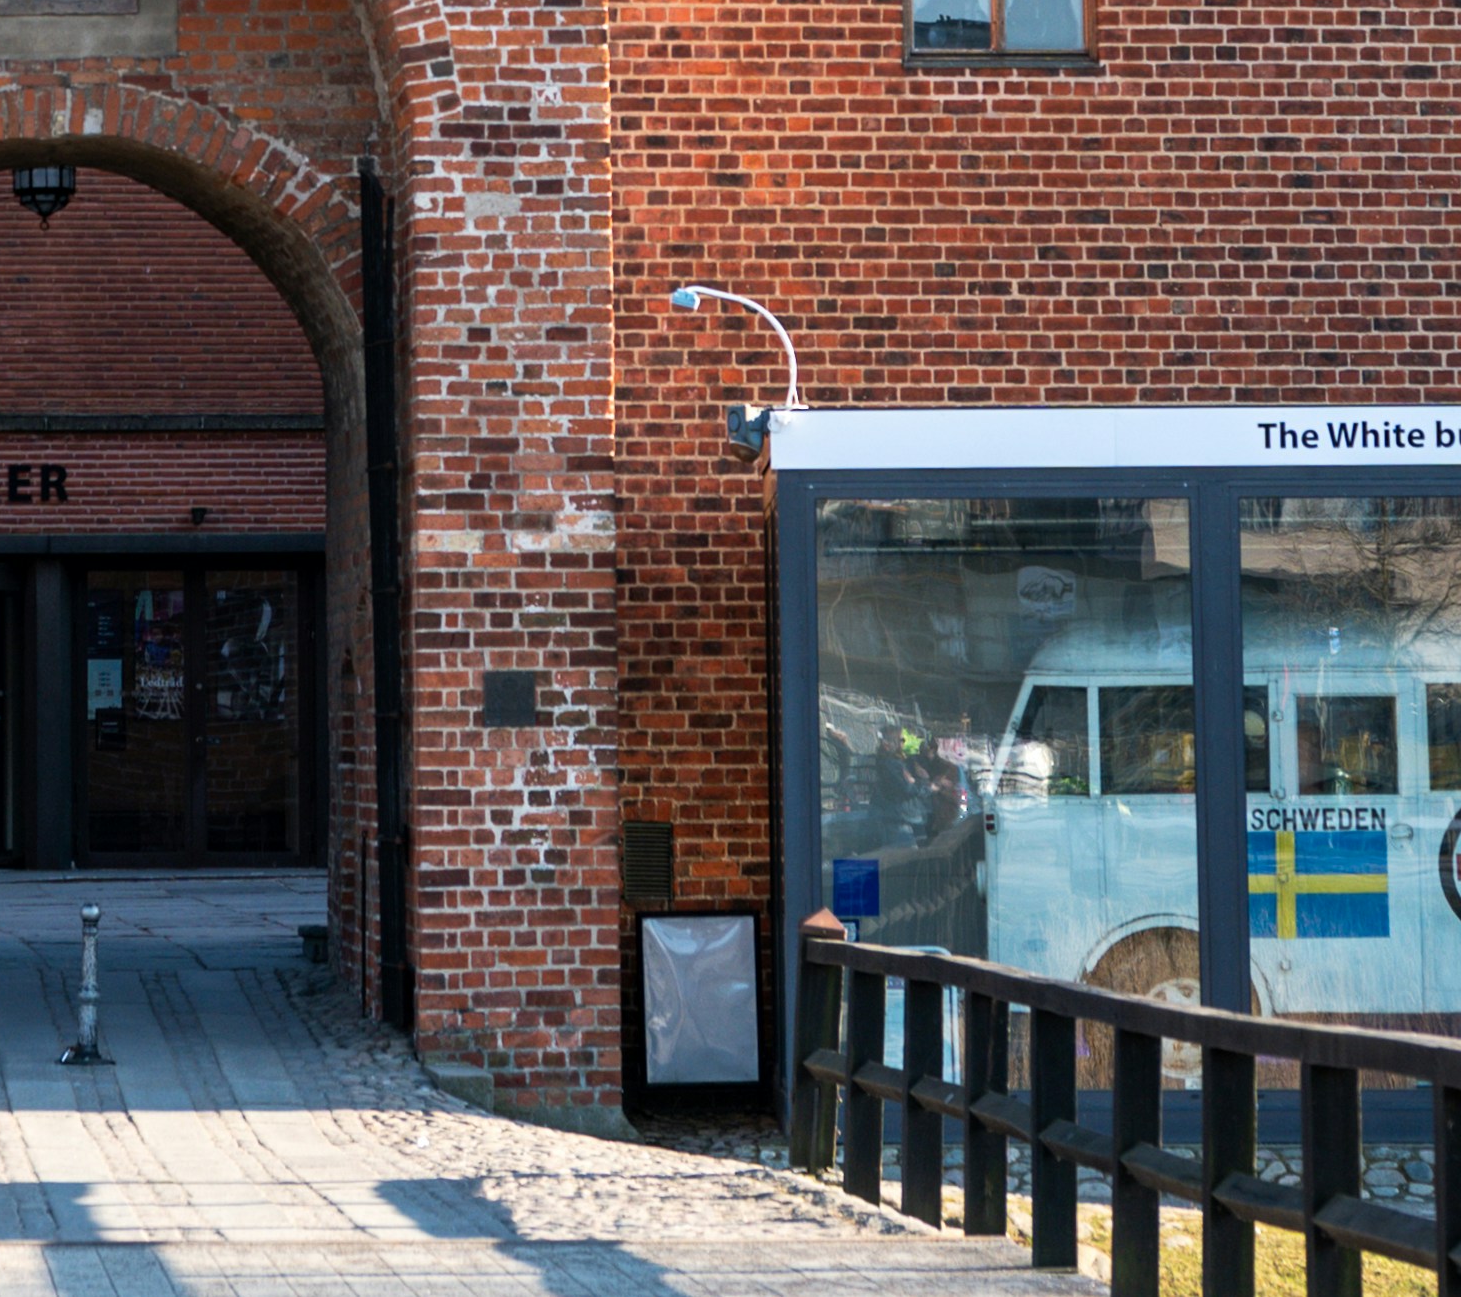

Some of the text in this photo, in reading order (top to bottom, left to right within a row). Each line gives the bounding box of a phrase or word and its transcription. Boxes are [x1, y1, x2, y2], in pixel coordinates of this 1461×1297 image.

[1257, 421, 1319, 449] The
[1326, 420, 1425, 449] White
[1250, 807, 1386, 831] SCHWEDEN
